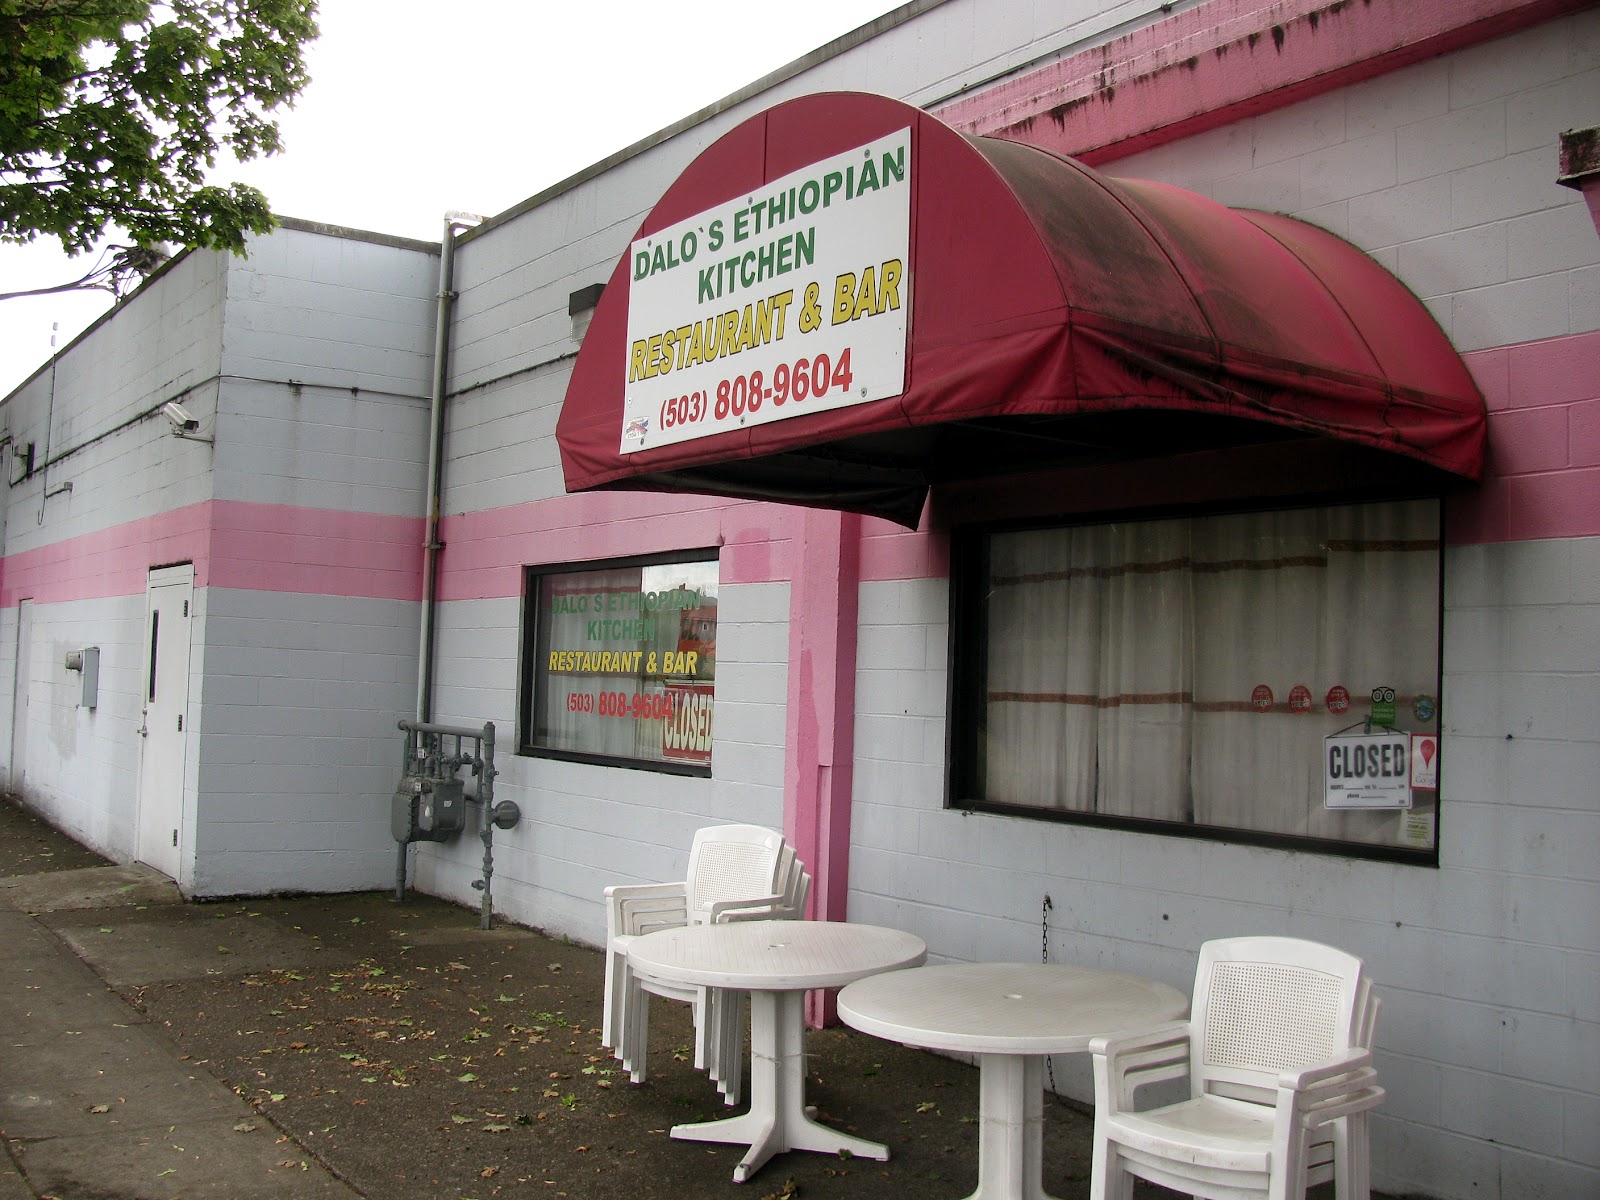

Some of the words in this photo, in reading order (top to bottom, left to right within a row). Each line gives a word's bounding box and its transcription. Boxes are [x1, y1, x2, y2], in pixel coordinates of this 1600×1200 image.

[734, 146, 905, 243] ETHIOPIAN
[698, 227, 816, 304] KITCHEN
[629, 289, 794, 383] RESTAURANT
[799, 281, 822, 333] &
[831, 258, 902, 326] BAR
[659, 390, 708, 430] (503)
[714, 348, 853, 421] 808-9604
[608, 588, 700, 612] ETHIOPIAN
[587, 618, 656, 641] KITCHEN
[549, 651, 643, 673] RESTAURANT
[646, 651, 658, 673] &
[662, 651, 698, 675] BAR
[566, 692, 594, 713] (503)
[597, 691, 673, 720] 808-9604
[664, 691, 714, 752] CLOSED
[1329, 743, 1405, 779] CLOSED
